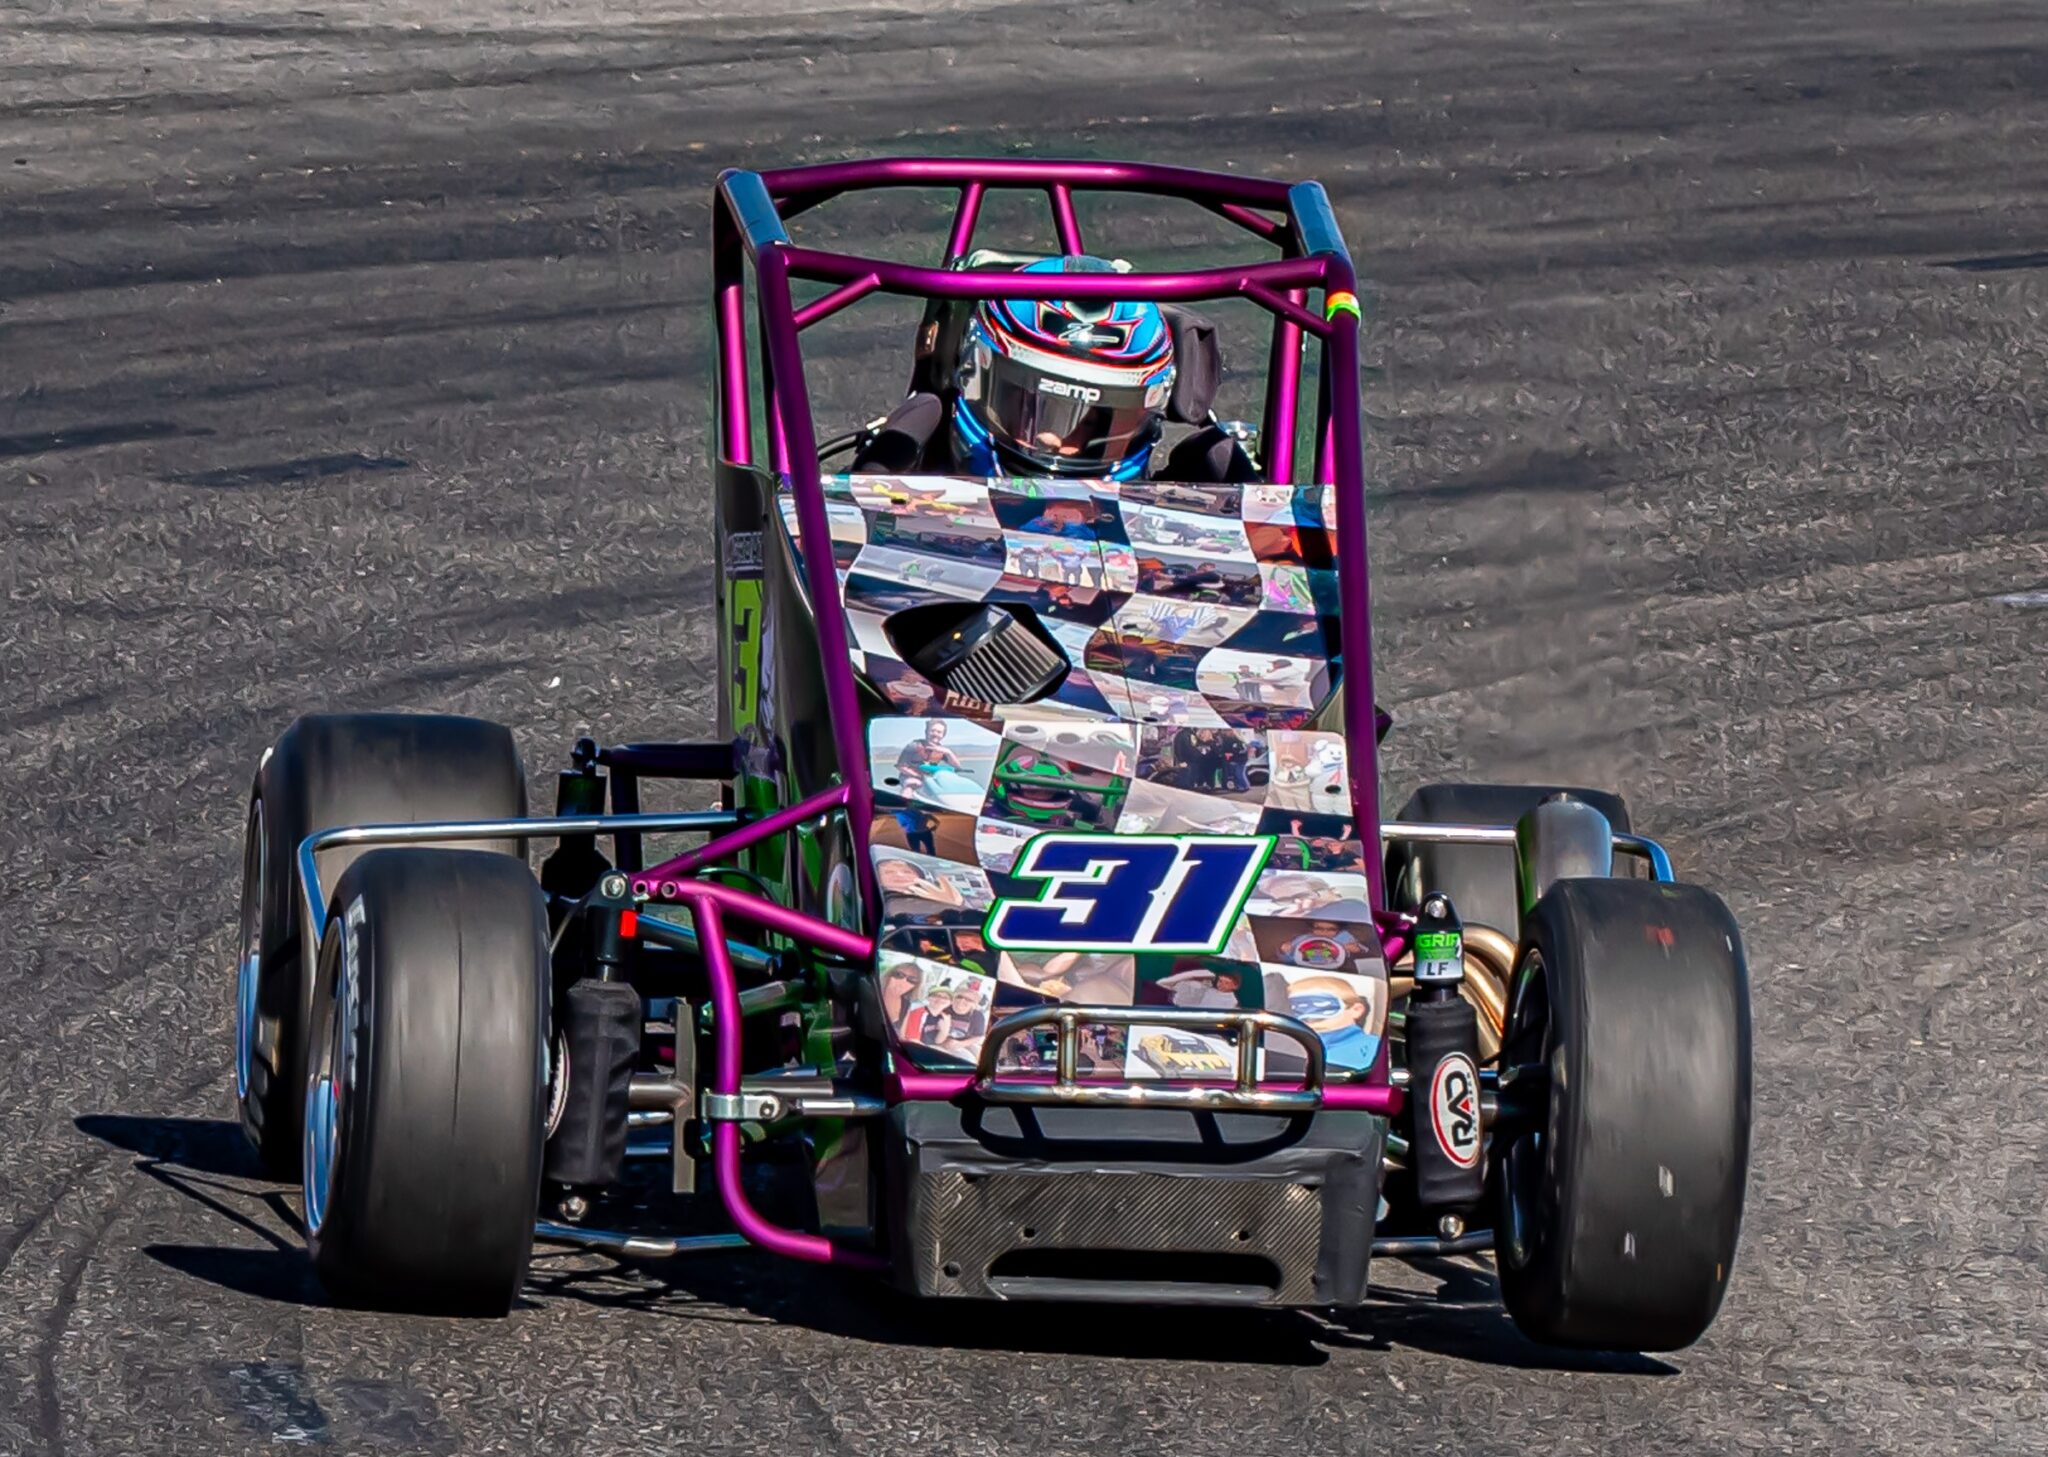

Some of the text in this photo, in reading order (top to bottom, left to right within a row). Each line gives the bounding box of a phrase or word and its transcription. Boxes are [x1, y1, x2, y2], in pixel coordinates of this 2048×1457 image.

[1039, 377, 1101, 404] zamp
[984, 833, 1276, 952] 31
[1426, 962, 1449, 976] LF
